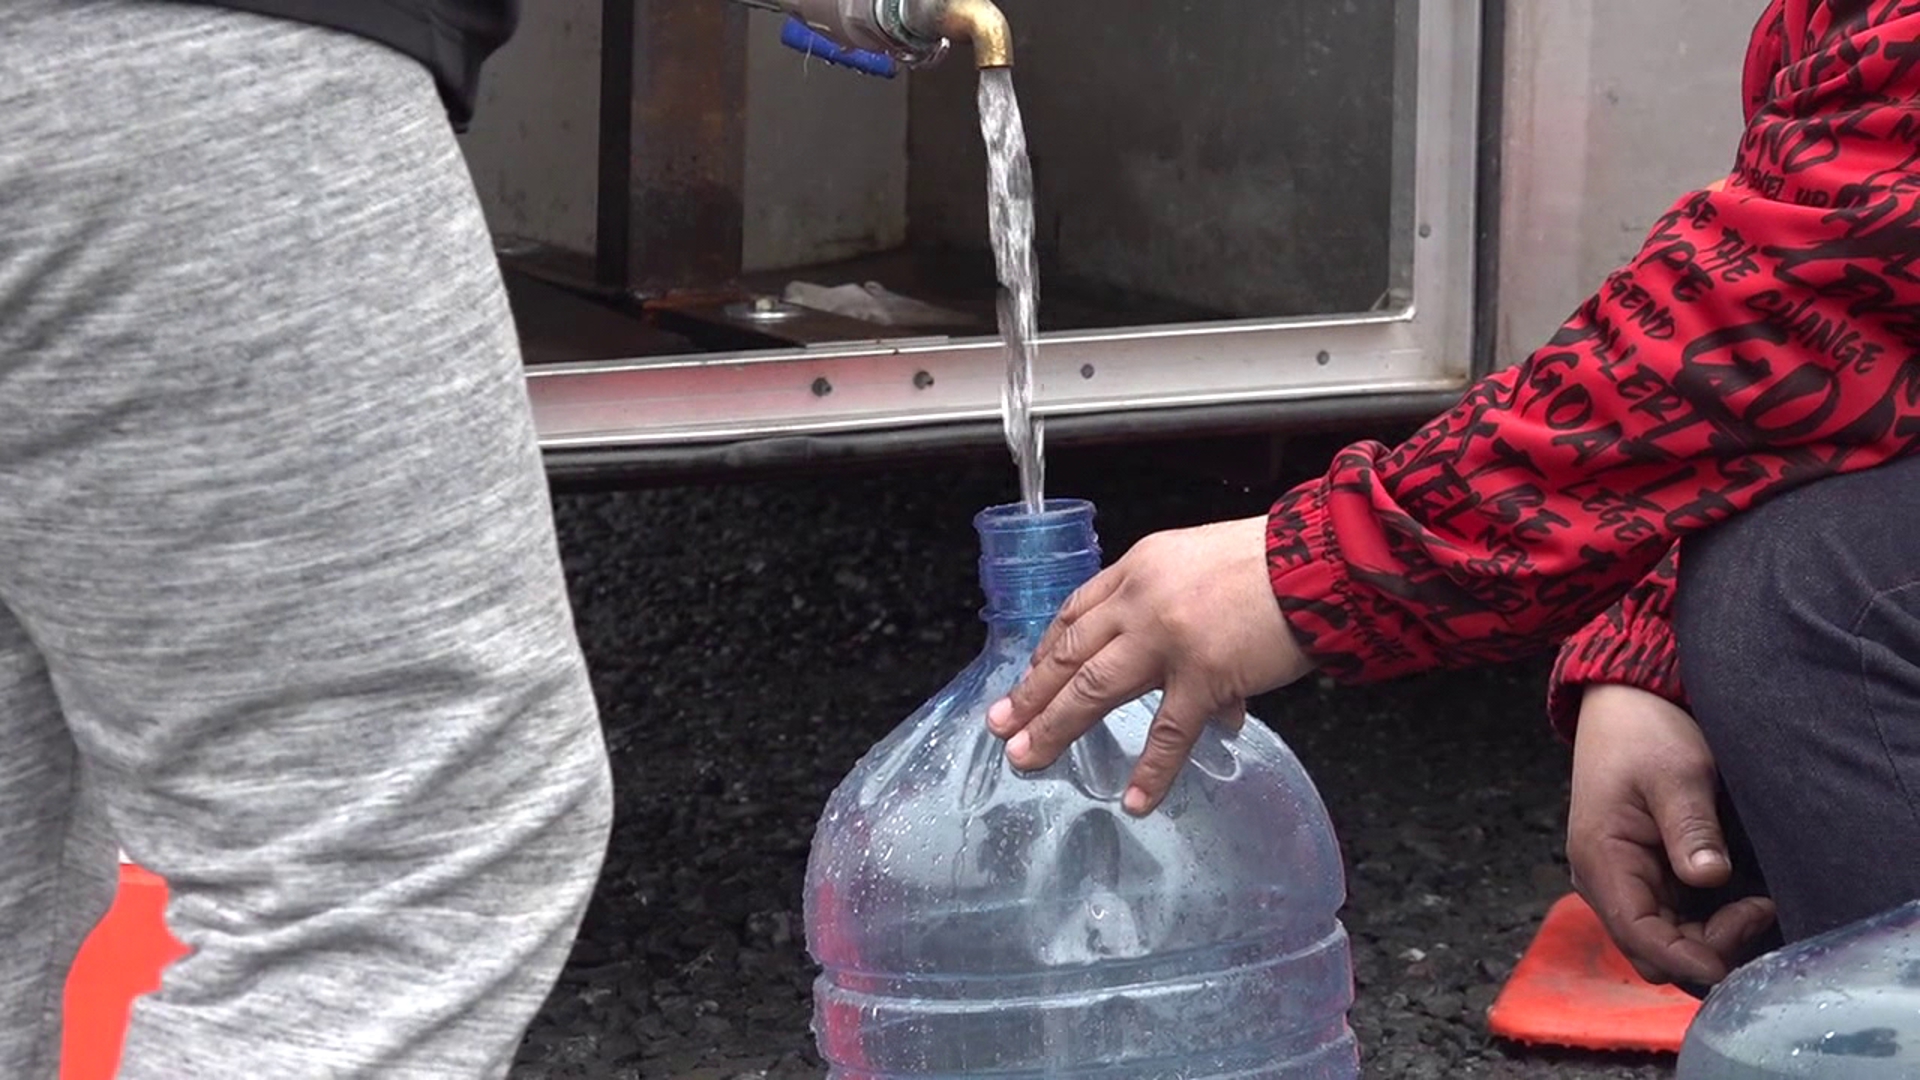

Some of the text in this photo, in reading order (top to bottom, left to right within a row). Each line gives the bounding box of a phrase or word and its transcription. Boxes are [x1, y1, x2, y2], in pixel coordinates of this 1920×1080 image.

[1607, 269, 1676, 340] GEND
[1698, 227, 1760, 283] THE
[1746, 289, 1885, 376] CHANGE
